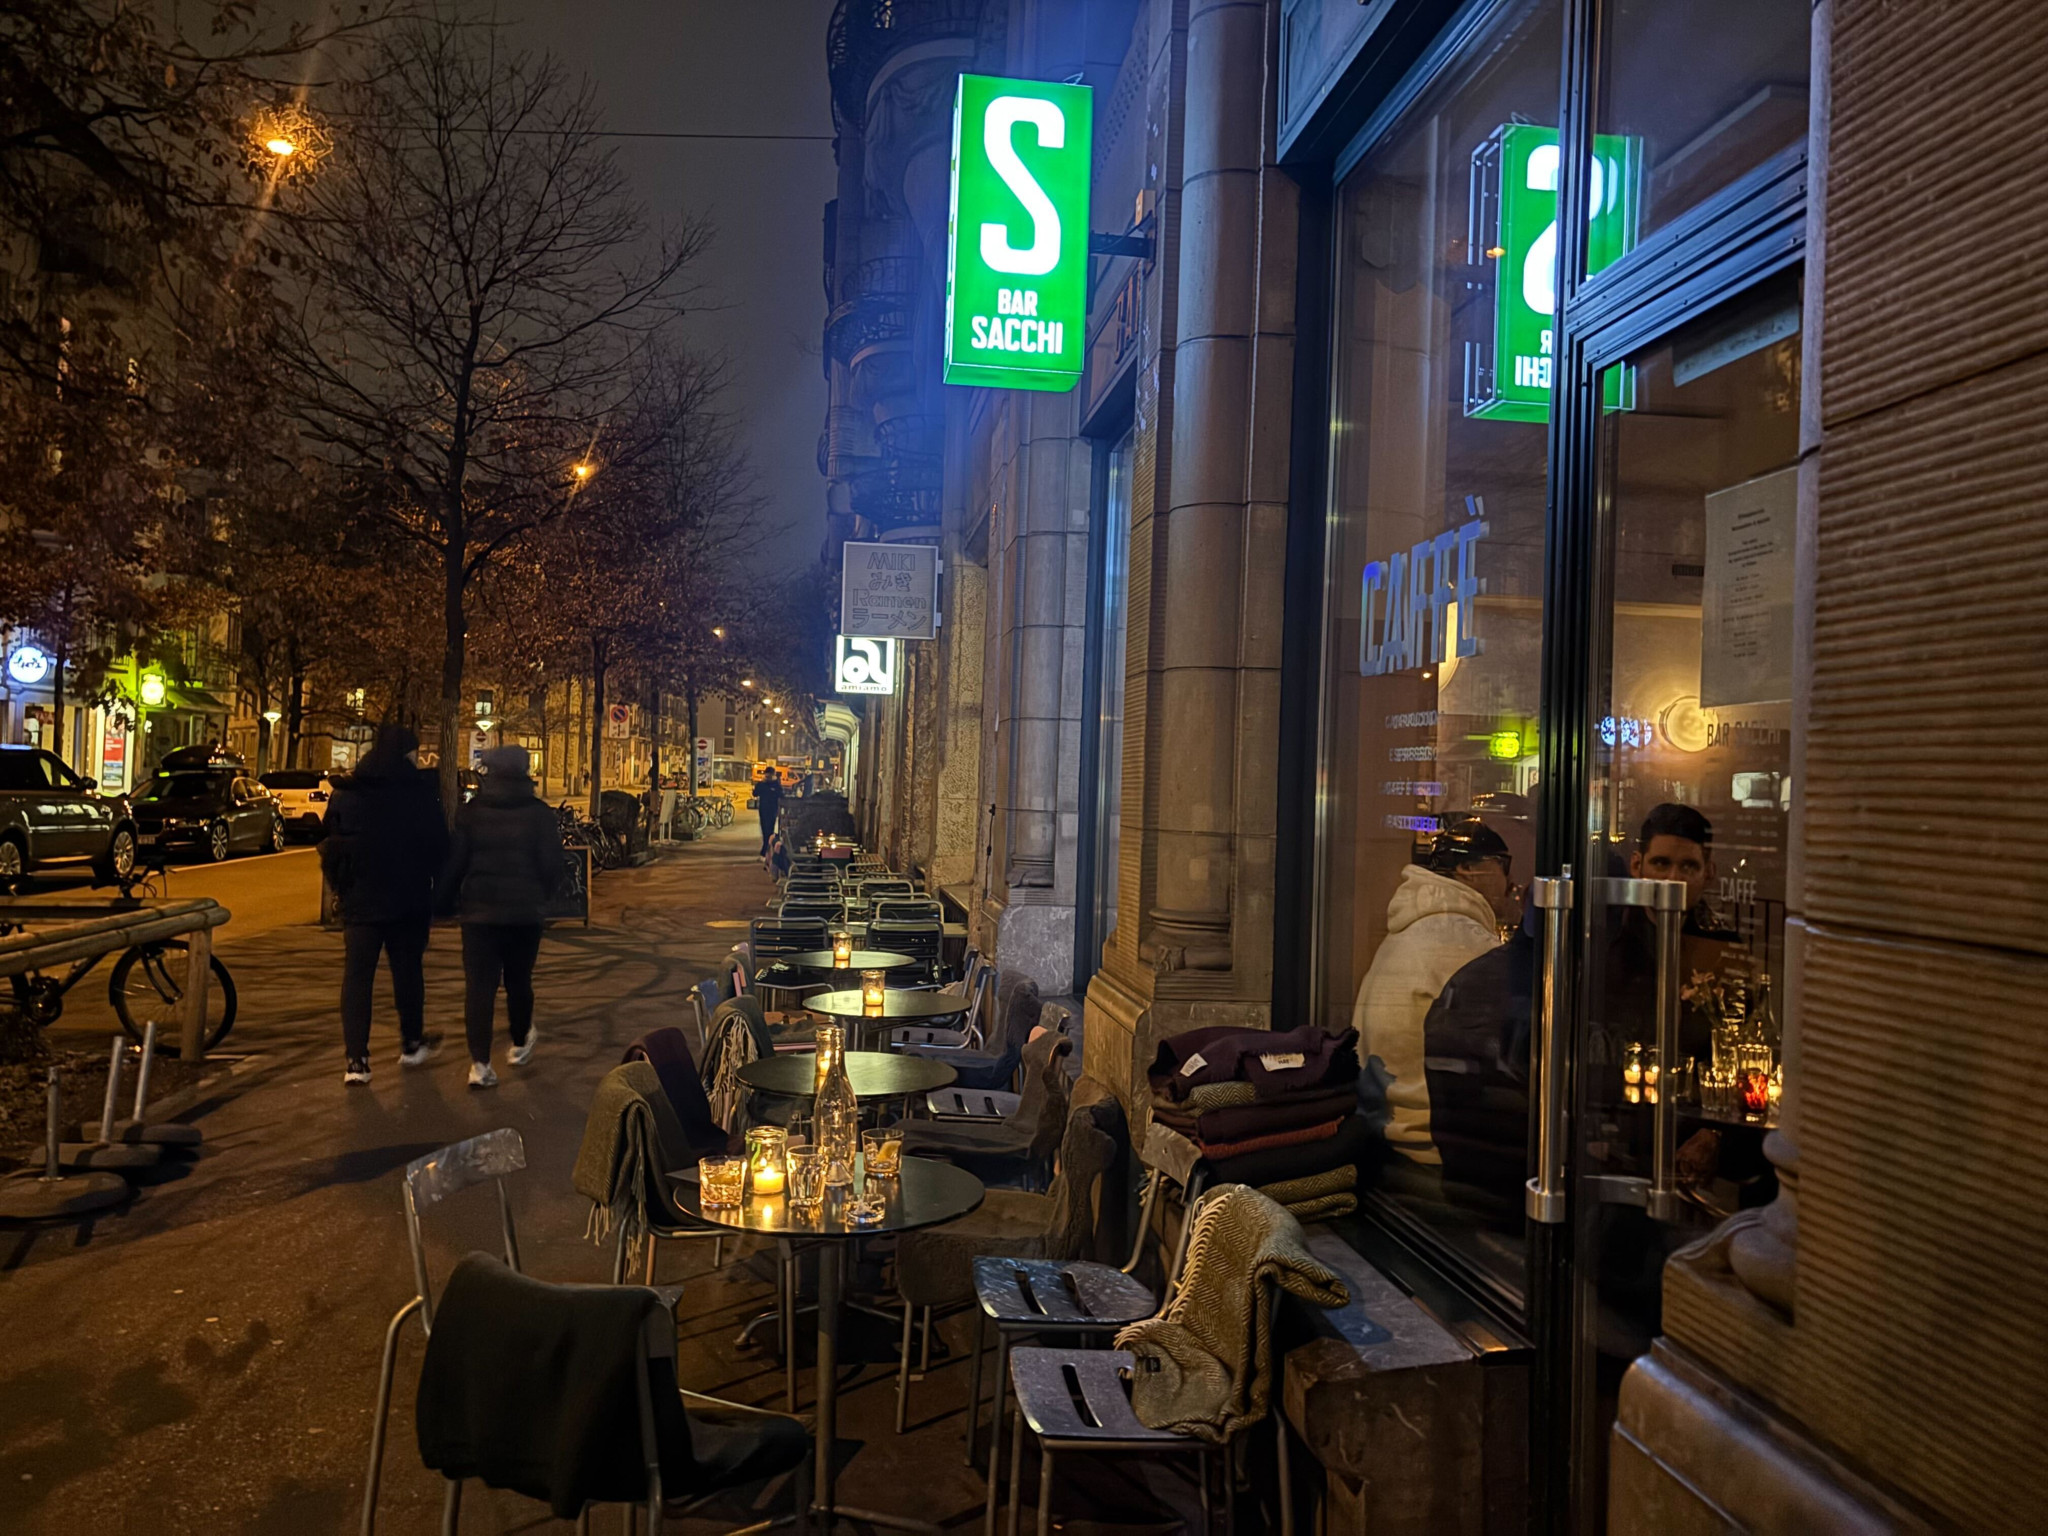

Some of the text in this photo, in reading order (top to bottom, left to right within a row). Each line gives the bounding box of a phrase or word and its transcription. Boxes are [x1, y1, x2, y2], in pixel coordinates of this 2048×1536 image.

[980, 96, 1065, 275] S
[997, 288, 1038, 317] BAR
[971, 315, 1064, 355] SACCHI
[867, 552, 916, 571] MIKI
[852, 588, 927, 610] Ramen
[852, 608, 928, 632] ラーメン
[841, 684, 888, 692] amiamo
[1707, 722, 1731, 747] BAR
